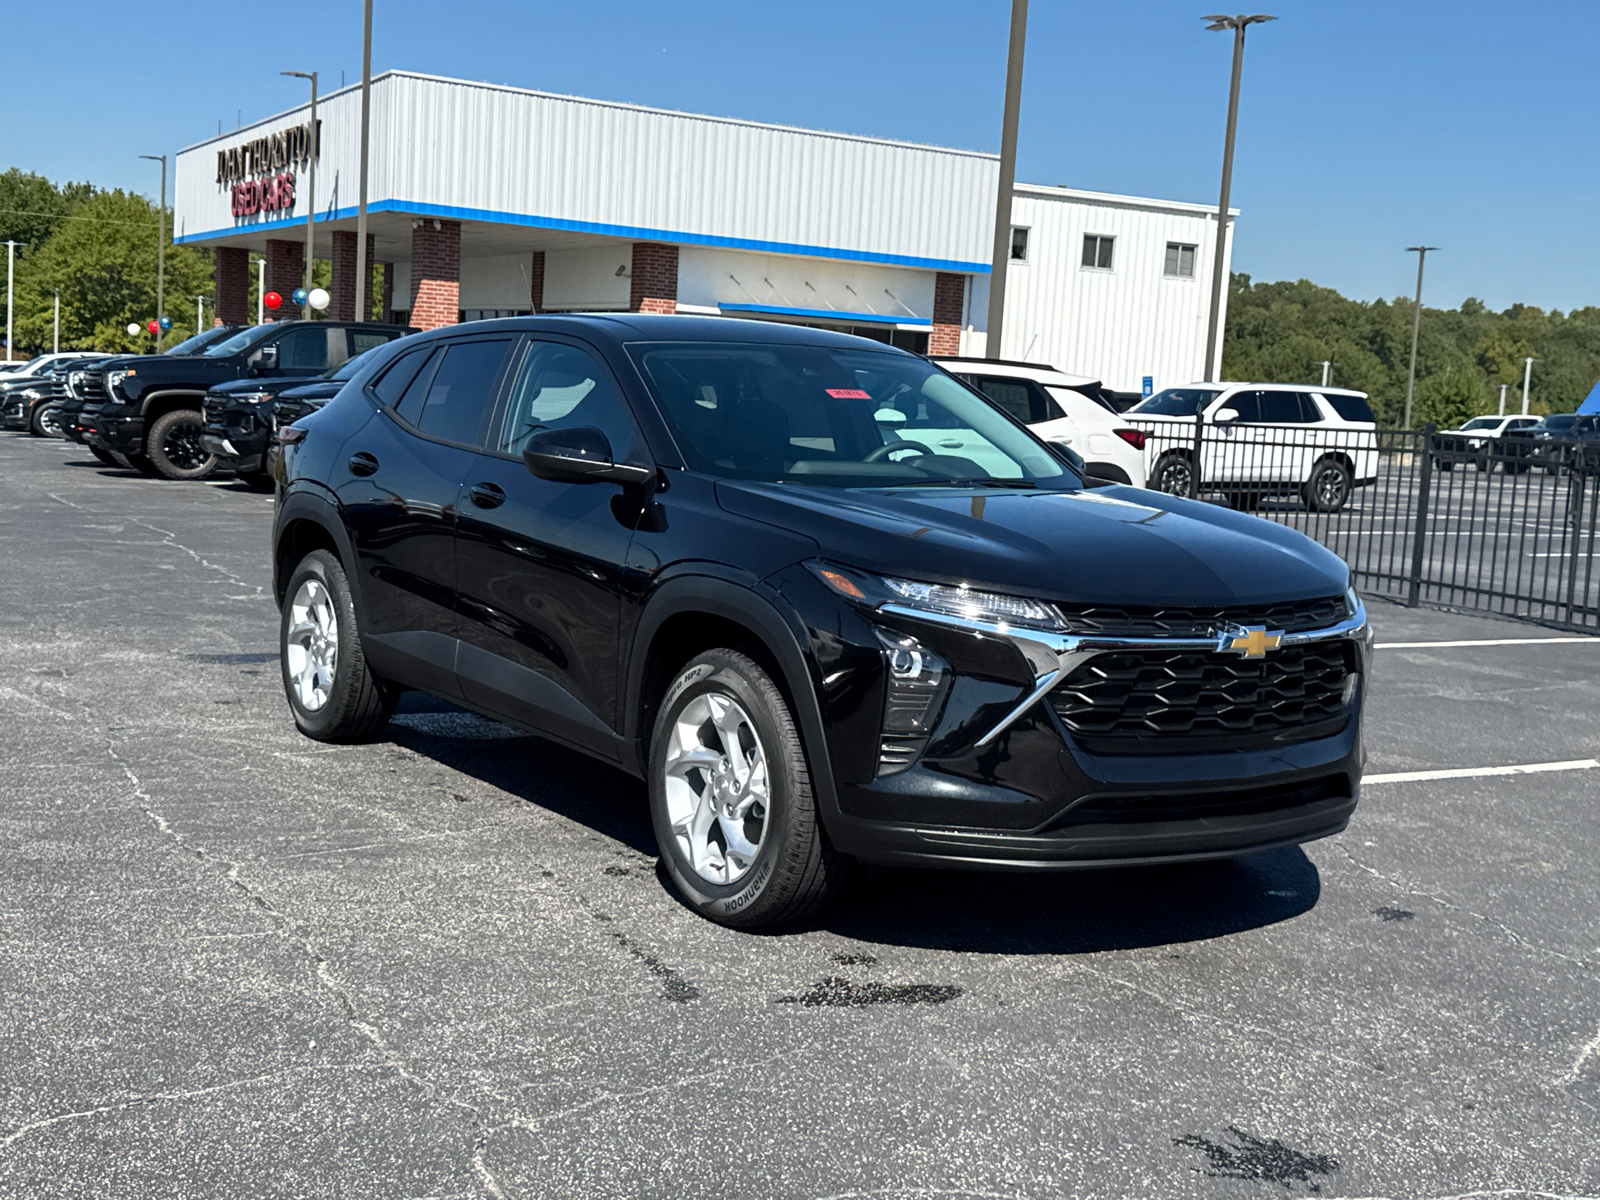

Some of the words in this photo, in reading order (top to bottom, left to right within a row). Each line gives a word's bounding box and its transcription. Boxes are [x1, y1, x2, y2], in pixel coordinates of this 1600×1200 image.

[216, 145, 248, 184] JOHN
[231, 180, 258, 217] USED
[260, 171, 292, 211] CARS
[684, 668, 702, 683] HP2
